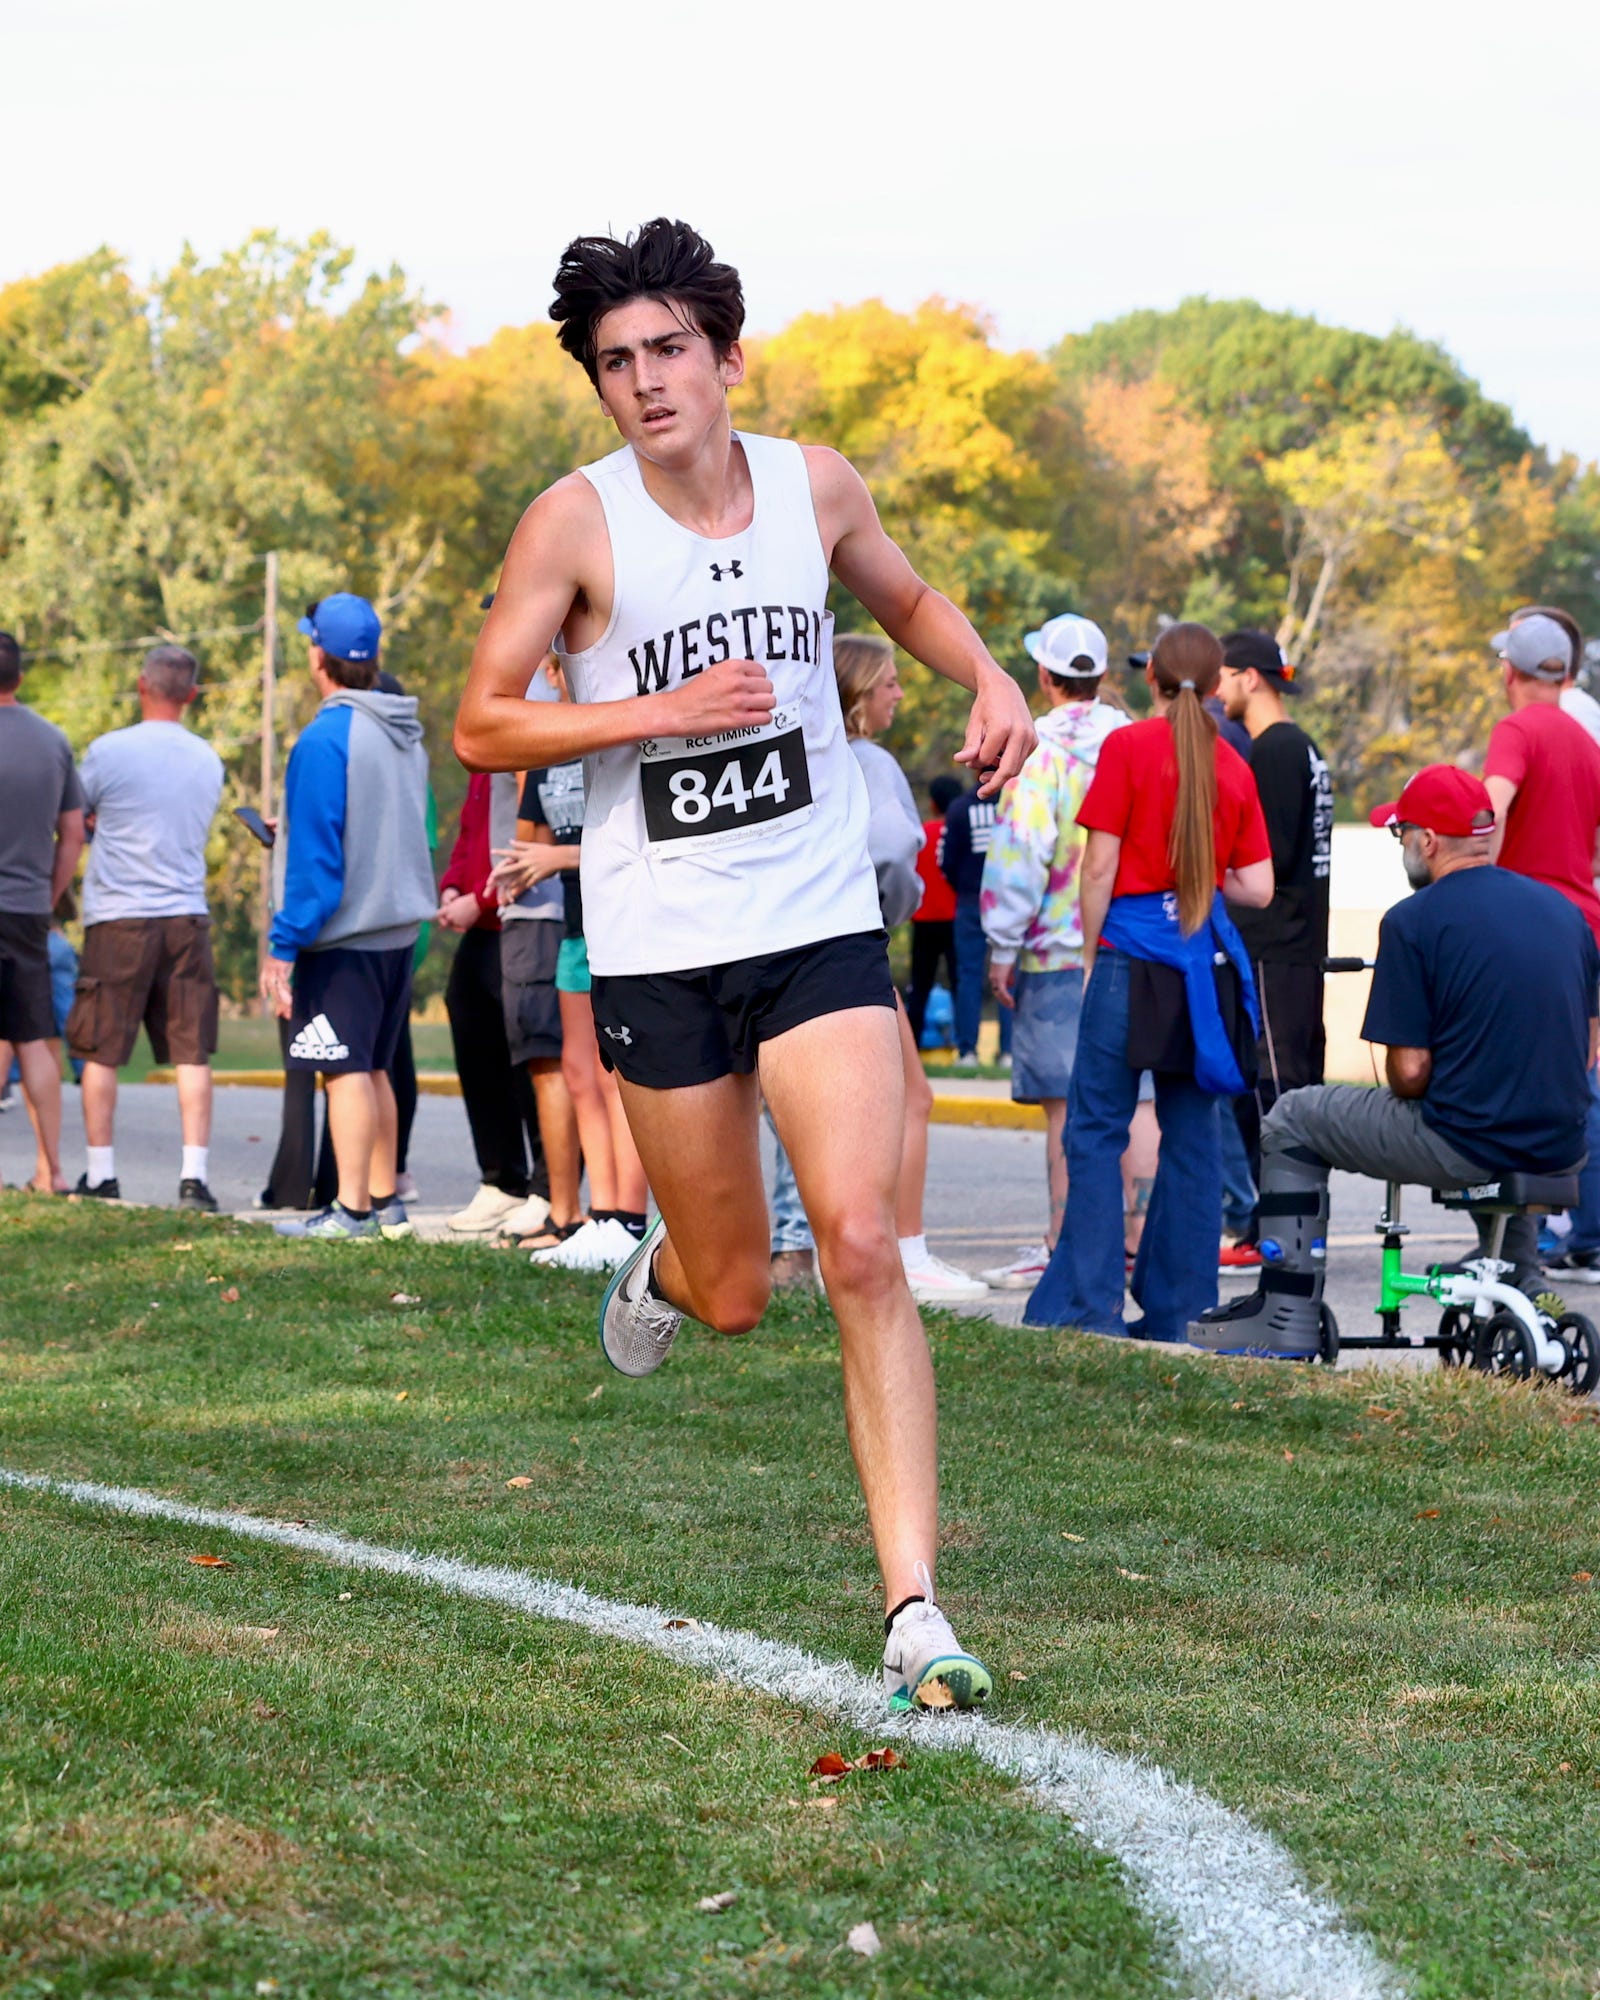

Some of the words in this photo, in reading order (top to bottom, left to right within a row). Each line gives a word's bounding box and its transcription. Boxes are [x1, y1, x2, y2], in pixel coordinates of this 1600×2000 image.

[685, 737, 713, 749] RCC
[715, 725, 761, 744] TIMING
[668, 750, 790, 824] 844
[289, 1042, 350, 1061] adidas
